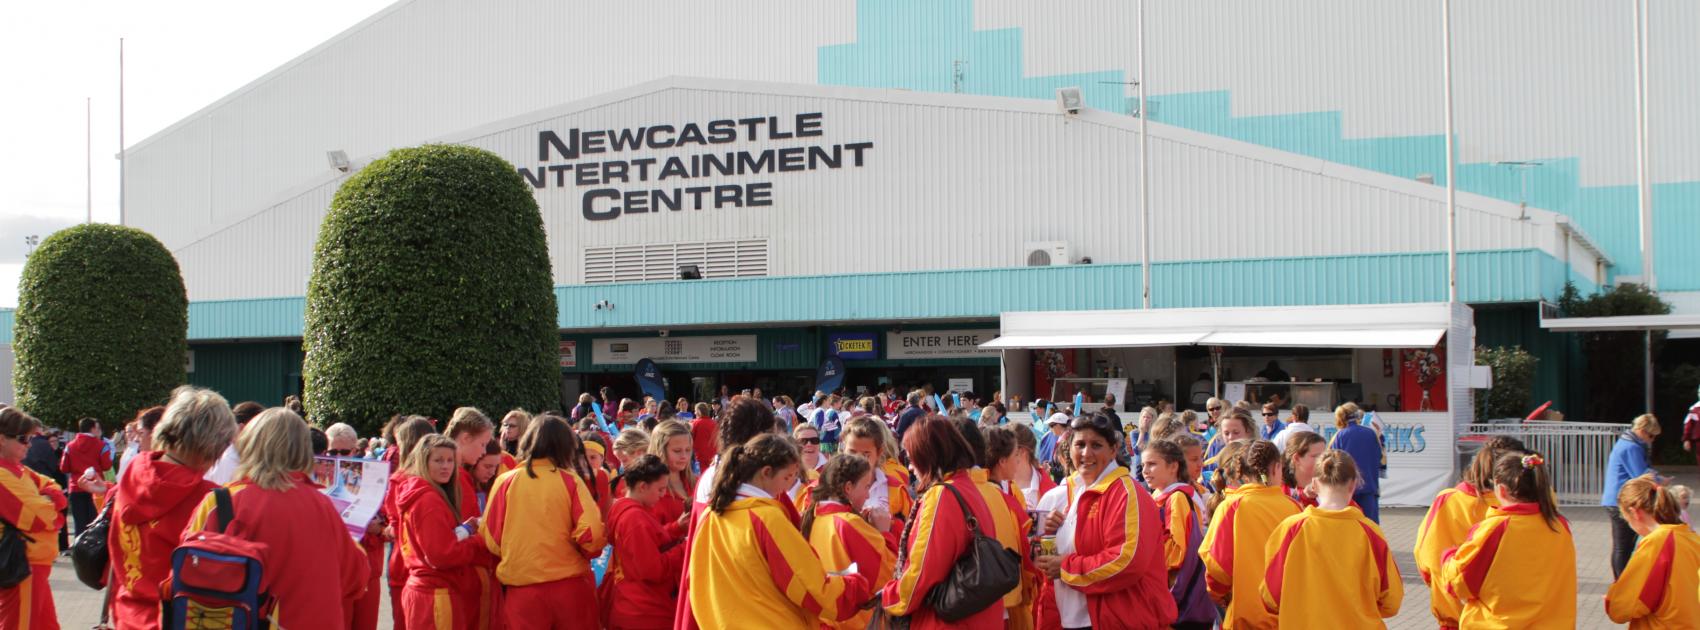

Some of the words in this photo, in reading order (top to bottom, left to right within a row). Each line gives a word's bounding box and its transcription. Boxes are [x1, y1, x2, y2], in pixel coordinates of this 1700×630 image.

[539, 112, 823, 162] NEWCASTLE
[517, 142, 874, 189] NTERTAINMENT
[582, 182, 773, 222] CENTRE
[903, 336, 941, 347] ENTER
[947, 335, 978, 346] HERE
